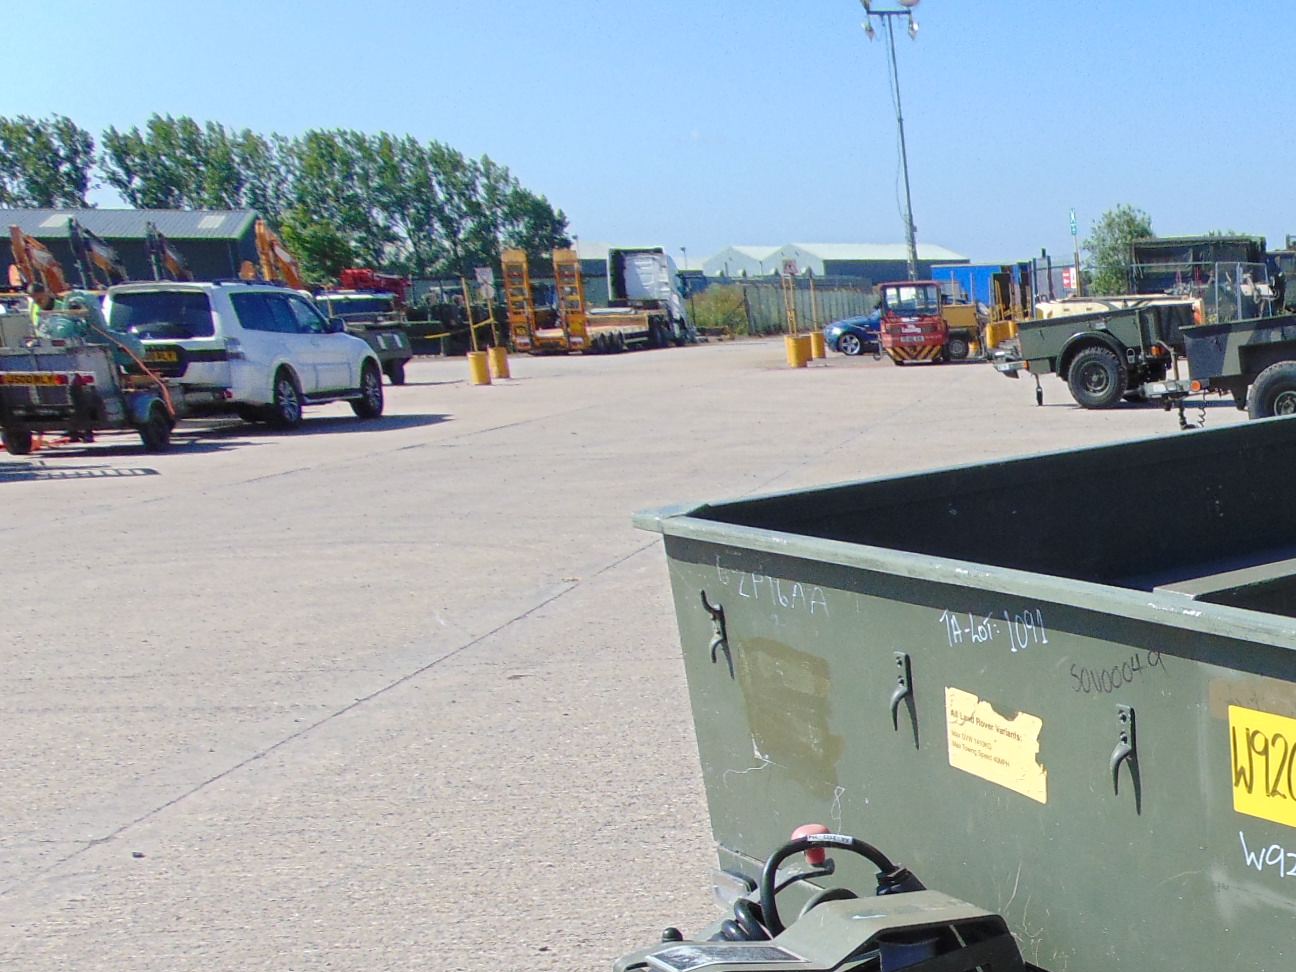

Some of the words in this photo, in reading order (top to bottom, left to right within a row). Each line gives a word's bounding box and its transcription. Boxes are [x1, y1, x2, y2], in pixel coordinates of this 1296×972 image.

[959, 711, 975, 724] Land
[975, 717, 994, 731] Rover
[977, 749, 993, 761] Speed
